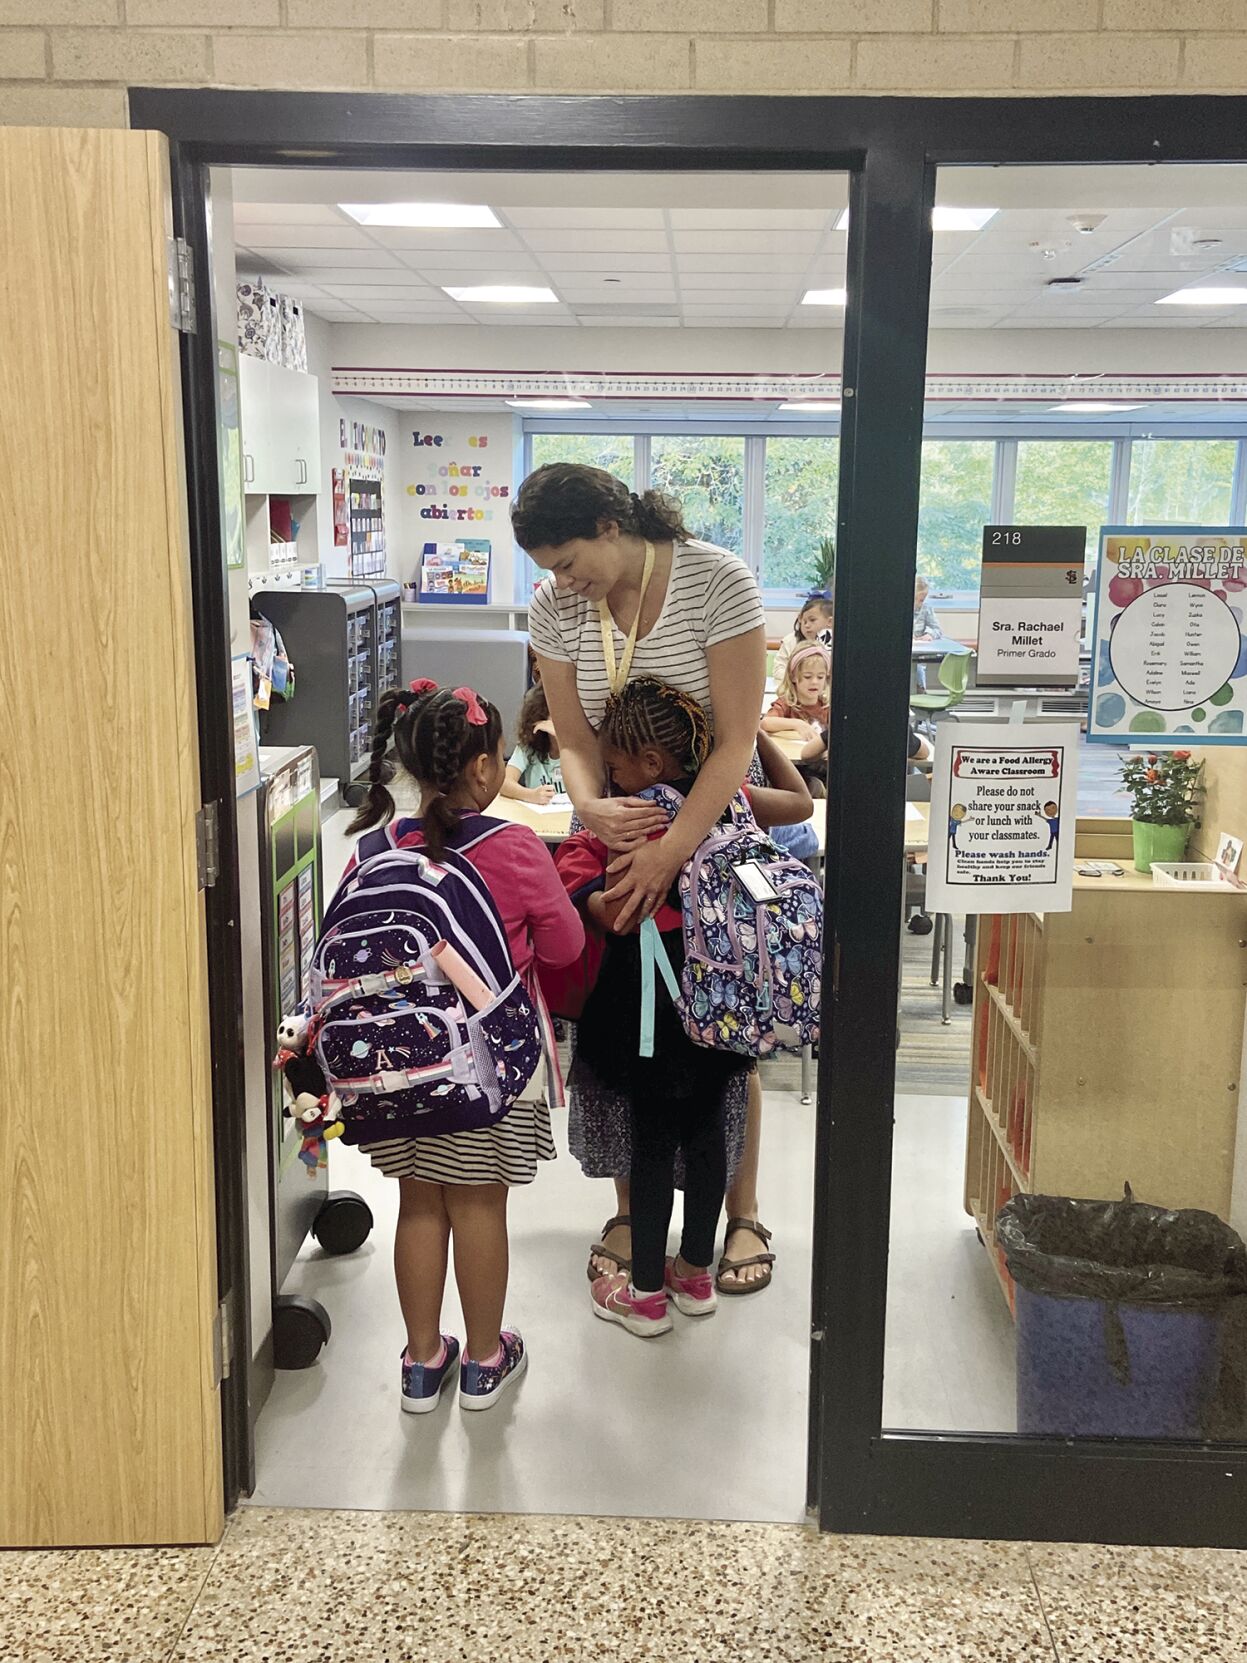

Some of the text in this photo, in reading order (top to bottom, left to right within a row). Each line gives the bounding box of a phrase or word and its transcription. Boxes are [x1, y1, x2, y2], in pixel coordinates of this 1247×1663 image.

[420, 503, 493, 521] abiertos
[992, 532, 1021, 545] 218
[1118, 546, 1244, 564] LA CLASE DE
[1117, 562, 1243, 579] SRA. MILLET
[992, 622, 1064, 631] Sra. Rachael
[1012, 636, 1042, 645] Millet
[997, 649, 1056, 657] Primer Grado
[999, 756, 1020, 764] Food
[1022, 757, 1052, 766] Allergy
[977, 786, 1034, 796] Please do not
[968, 800, 1041, 813] share your snack
[987, 815, 1012, 825] lunch
[1014, 815, 1032, 825] with
[969, 830, 1040, 842] your classmates.
[955, 850, 986, 858] Please
[1018, 850, 1050, 858] hands.
[375, 1049, 394, 1070] A
